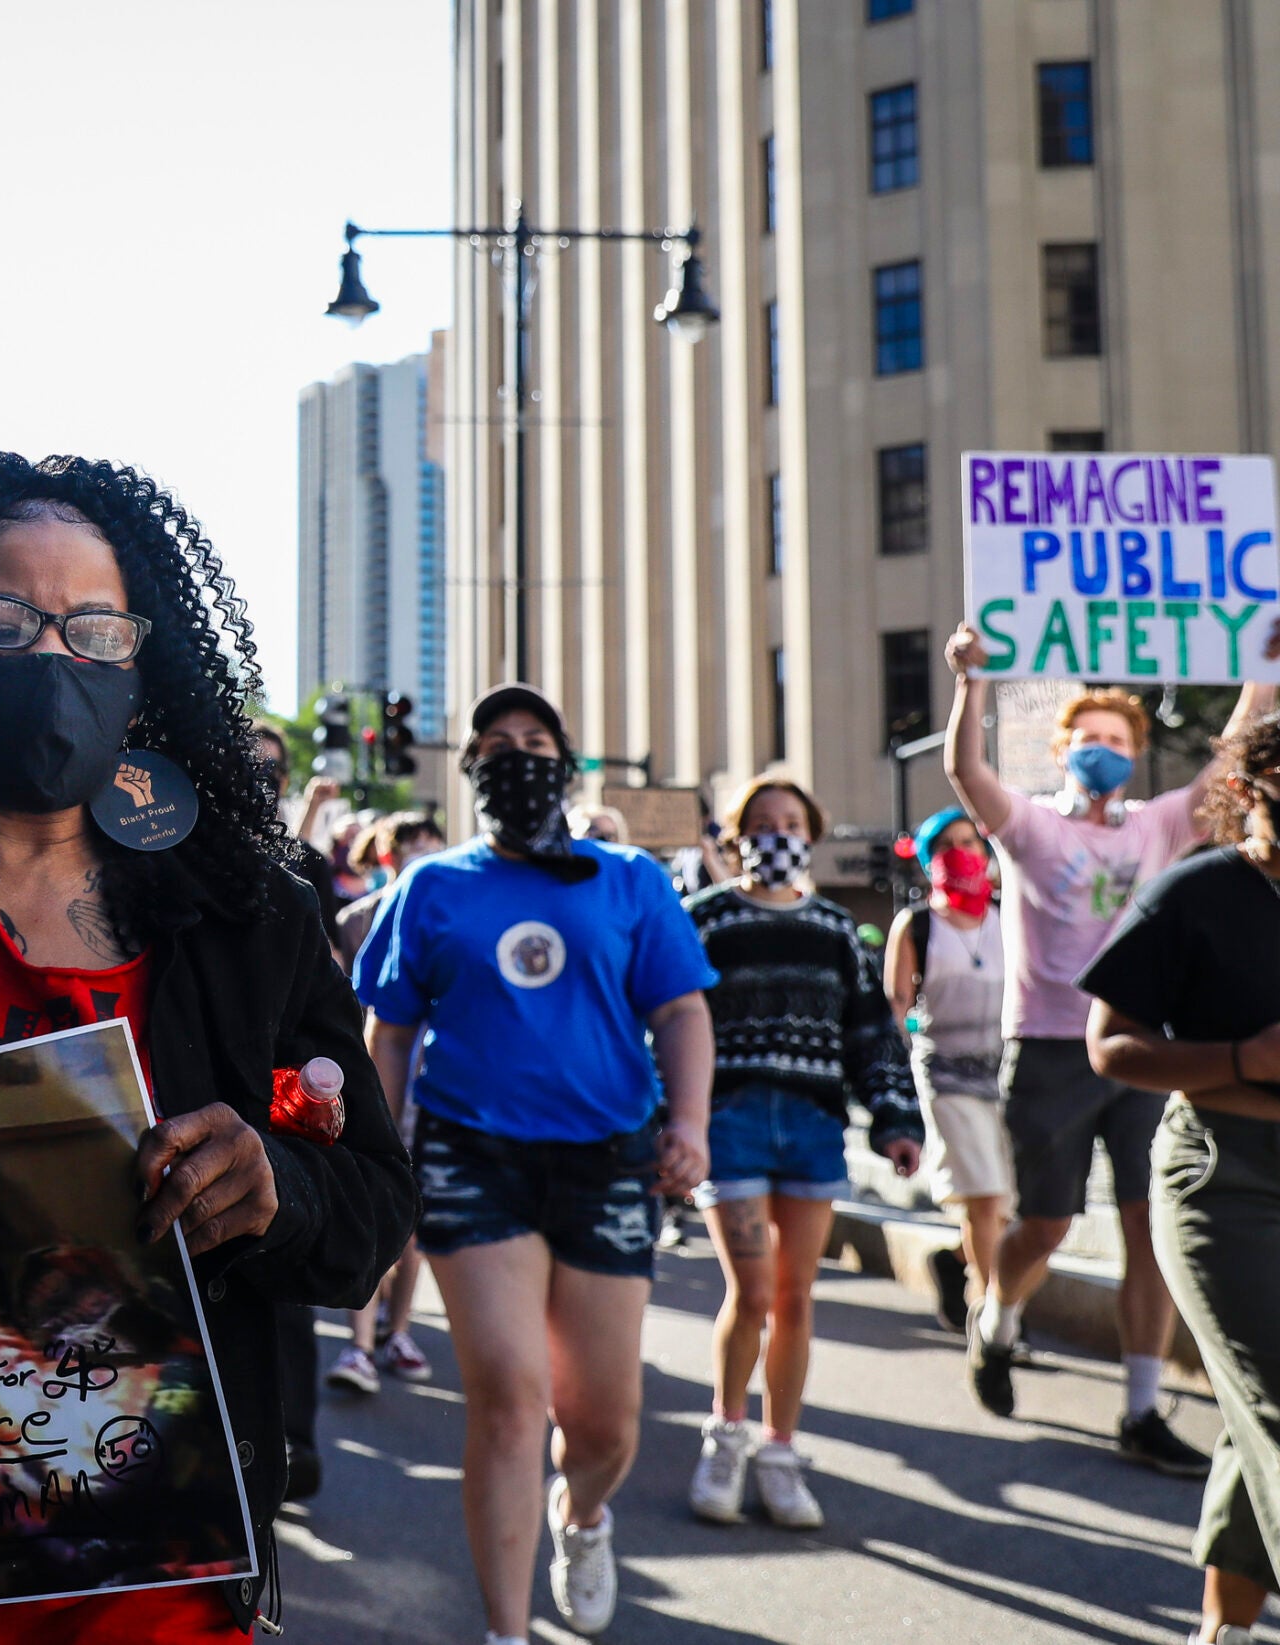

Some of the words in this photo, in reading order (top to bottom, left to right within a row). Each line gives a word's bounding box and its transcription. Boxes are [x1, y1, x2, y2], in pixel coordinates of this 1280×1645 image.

[970, 458, 1225, 525] REIMAGINE
[1022, 529, 1278, 600] PUBLIC
[980, 598, 1260, 678] SAFETY
[119, 812, 146, 826] Black
[147, 803, 176, 818] Proud
